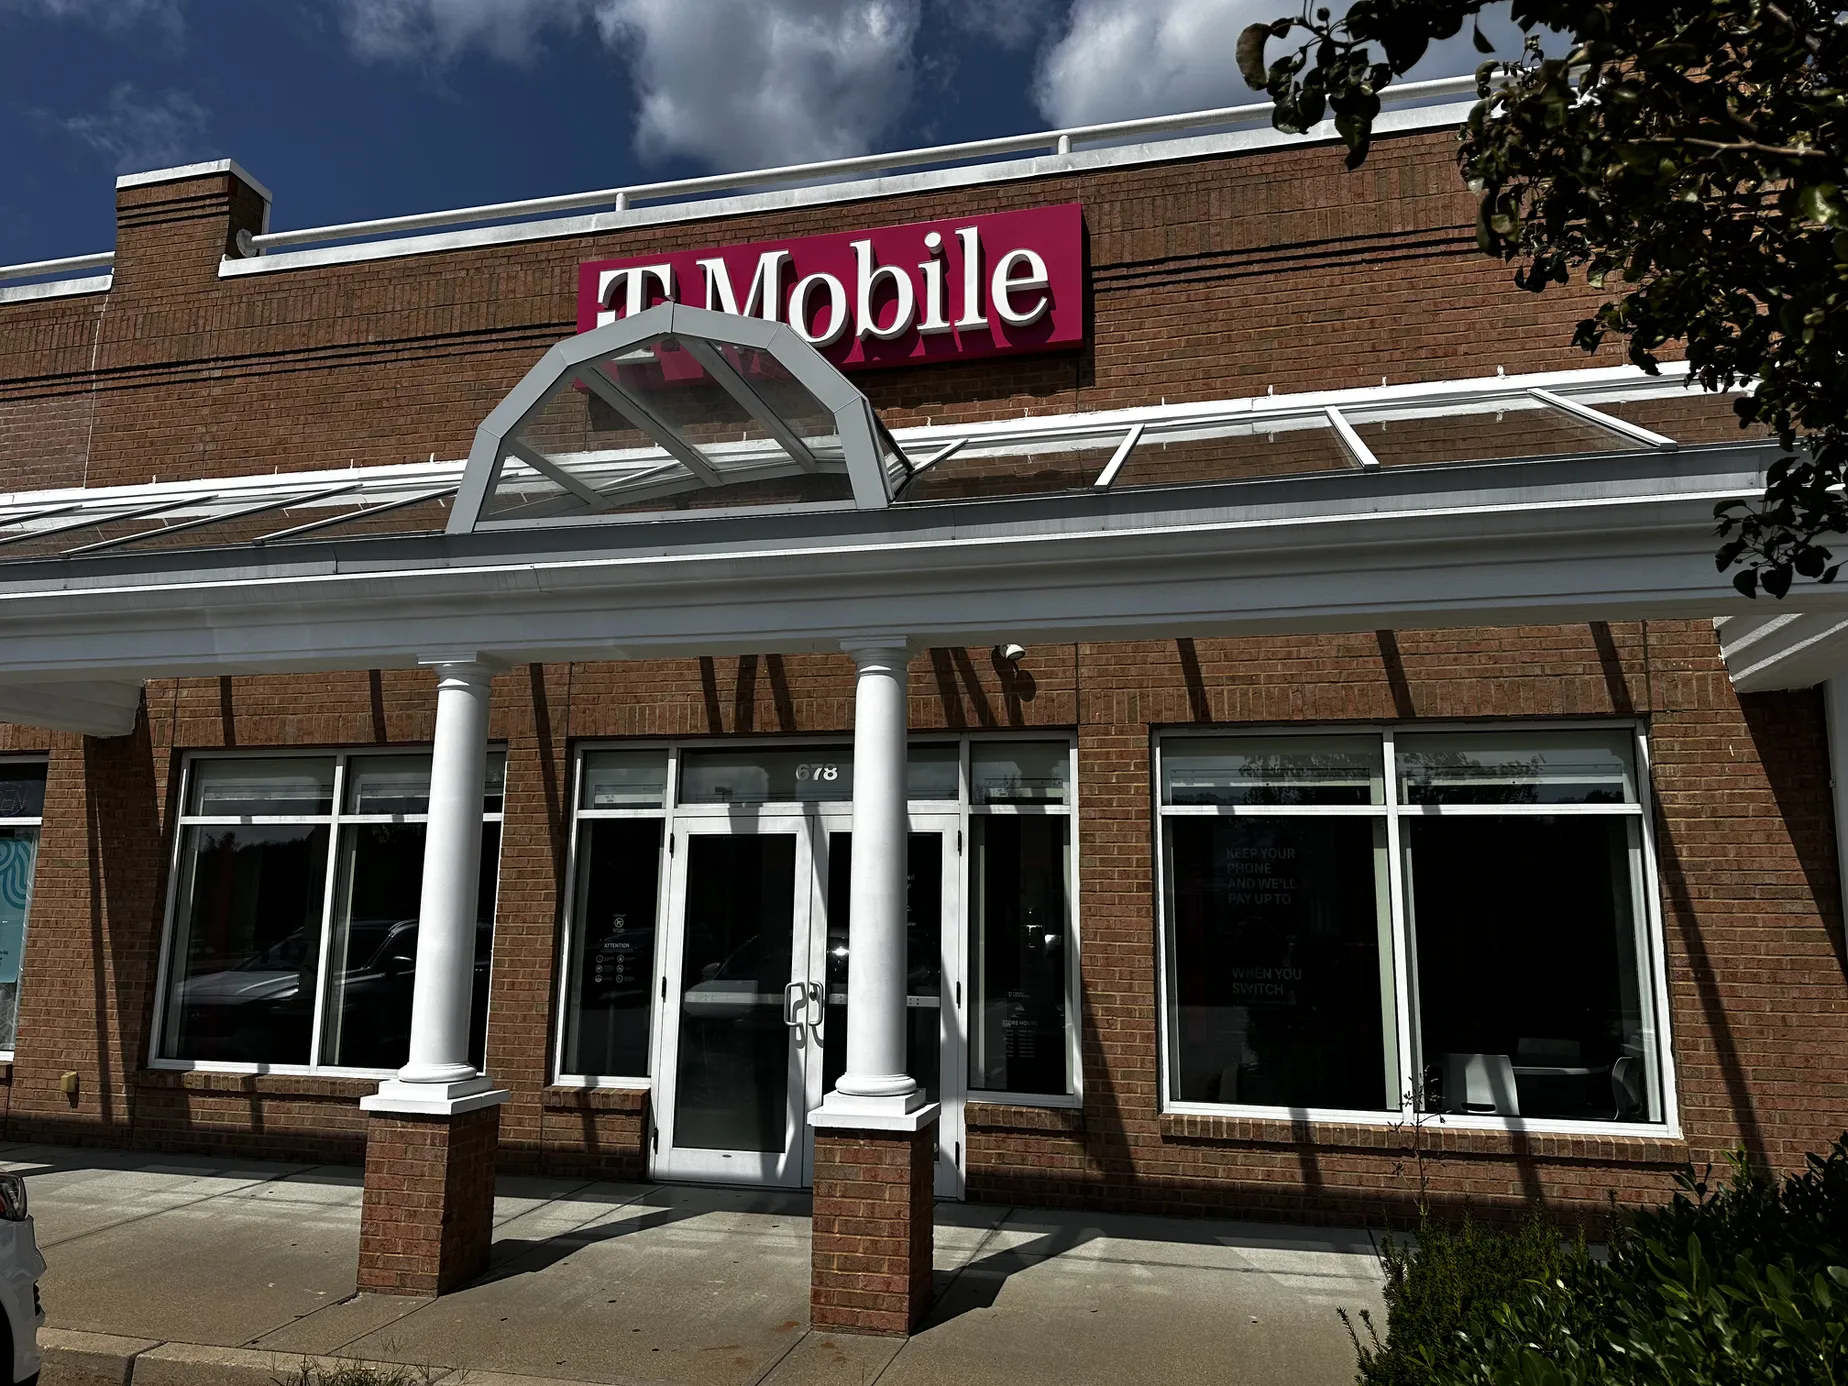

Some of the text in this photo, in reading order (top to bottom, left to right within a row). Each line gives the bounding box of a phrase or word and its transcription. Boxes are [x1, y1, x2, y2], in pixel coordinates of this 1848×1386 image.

[696, 226, 1048, 348] Mobile
[795, 763, 838, 780] 678
[1226, 847, 1296, 860] KEEP YOUR
[1226, 862, 1272, 874] PHONE
[1228, 877, 1297, 889] AND WE'LL
[1228, 892, 1292, 905] PAY UP TO
[1231, 966, 1302, 981] WHEN YOU
[1231, 982, 1284, 995] SWITCH
